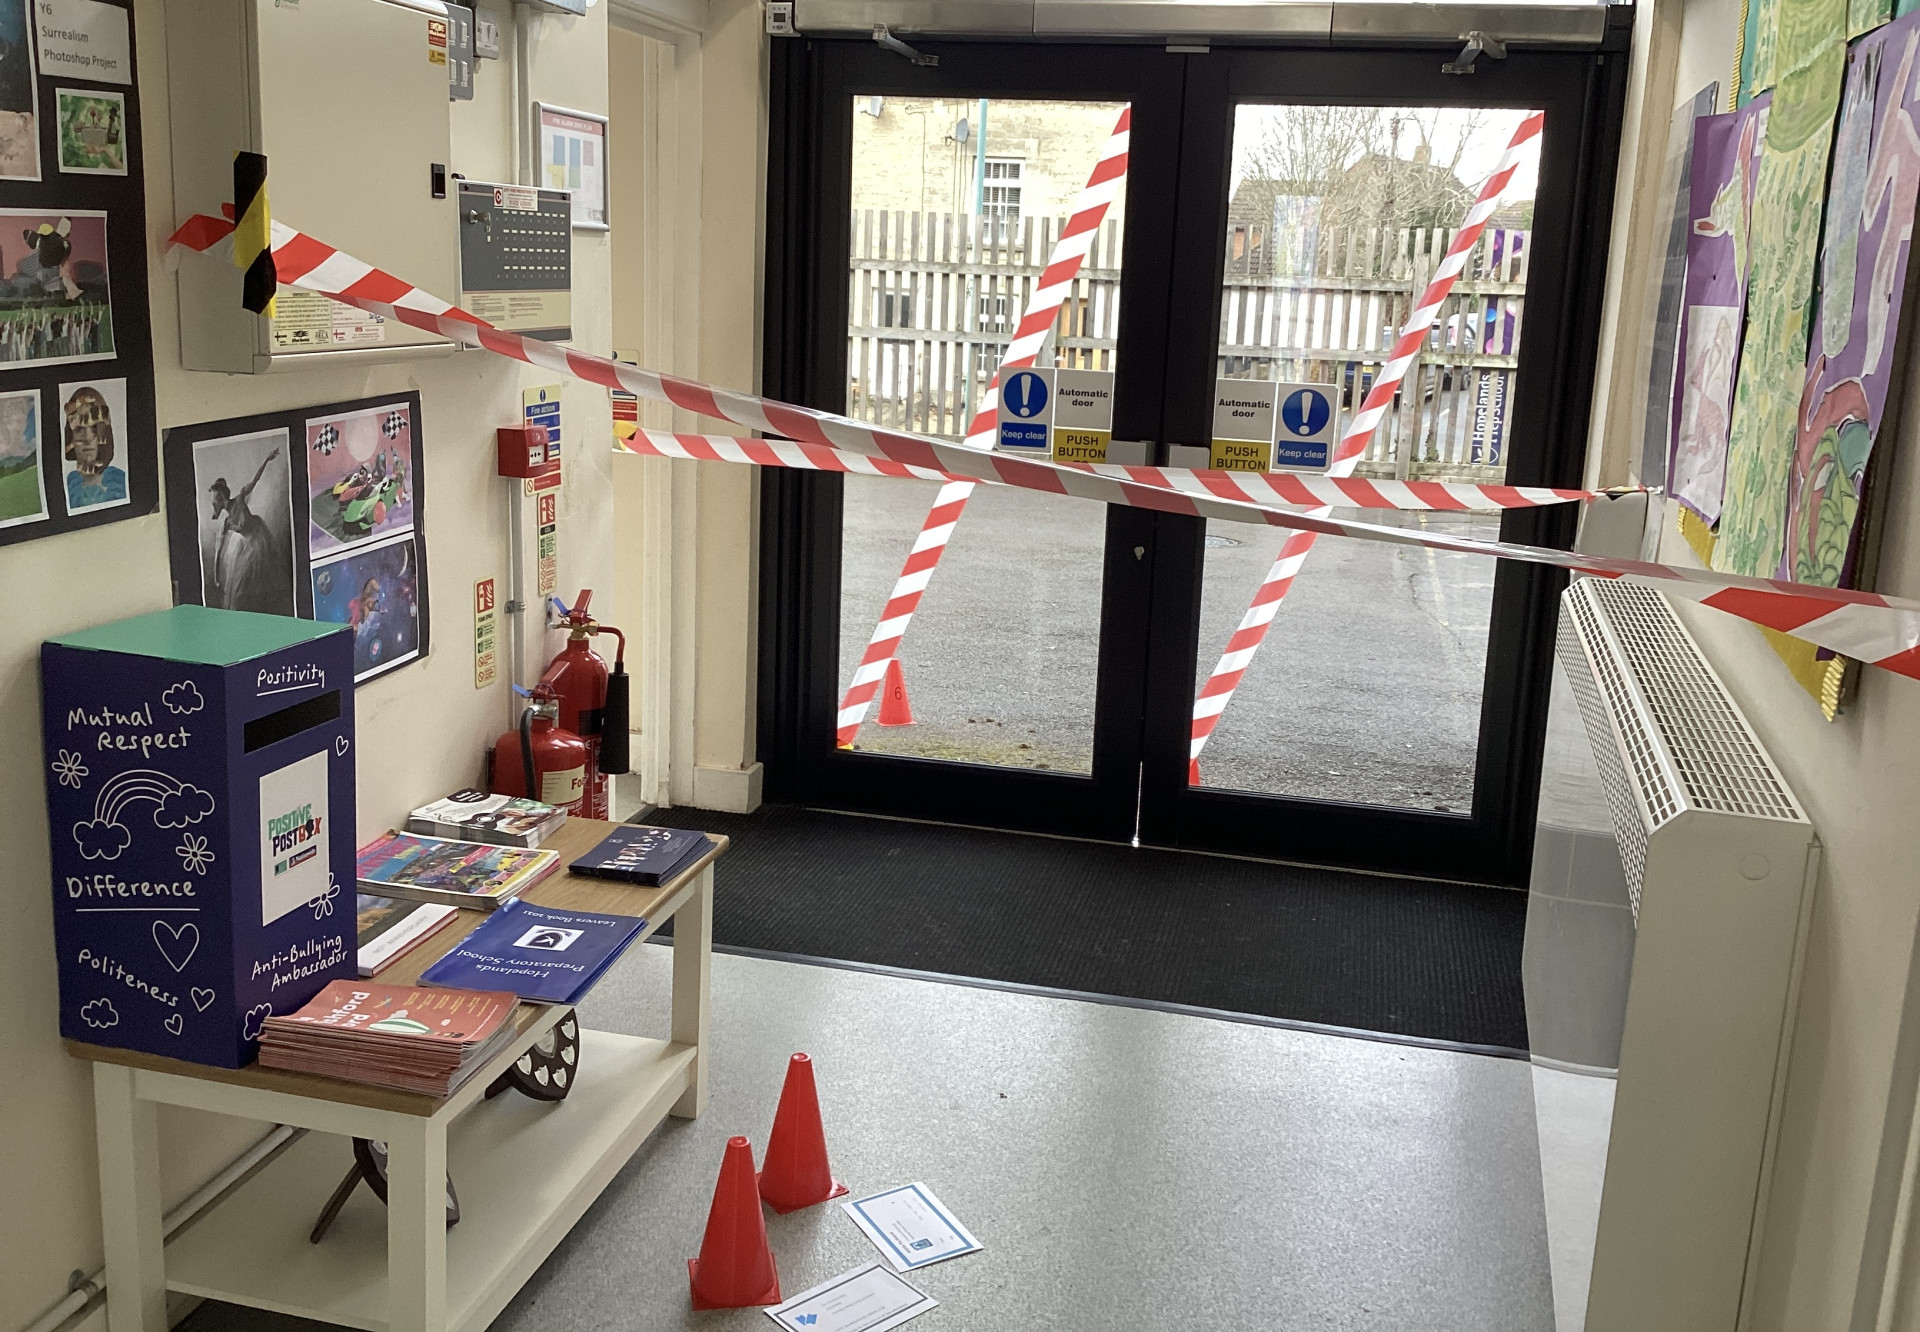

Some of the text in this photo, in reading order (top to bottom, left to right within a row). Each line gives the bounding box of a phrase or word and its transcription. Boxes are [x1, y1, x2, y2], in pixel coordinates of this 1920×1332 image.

[40, 3, 52, 15] Y6
[41, 26, 89, 42] Surrealism
[44, 48, 117, 70] Photoshop Project
[1058, 387, 1109, 398] Automatic
[531, 404, 556, 415] Fire action
[1072, 399, 1094, 407] door
[1218, 398, 1271, 409] Automatic
[1473, 374, 1490, 441] Hopelands
[1232, 409, 1255, 418] door
[1001, 429, 1046, 440] Keep clear
[1066, 435, 1099, 446] PUSH
[1058, 446, 1106, 459] BUTTON
[1225, 446, 1259, 457] PUSH
[1279, 448, 1327, 459] Keep clear
[1216, 458, 1266, 470] BUTTON
[257, 663, 325, 689] Positivity
[894, 686, 902, 700] 6
[67, 702, 153, 731] Mutual
[97, 726, 192, 759] Respect
[268, 803, 312, 840] POSITIVE
[66, 874, 196, 898] Difference
[522, 909, 616, 928] Leavers Book 2021
[251, 935, 342, 981] Anti-Bullying
[456, 949, 586, 973] Preparatory School
[78, 949, 179, 1007] Politeness
[271, 950, 348, 993] Ambassador
[475, 964, 550, 979] Hopelands
[318, 991, 371, 1025] shford
